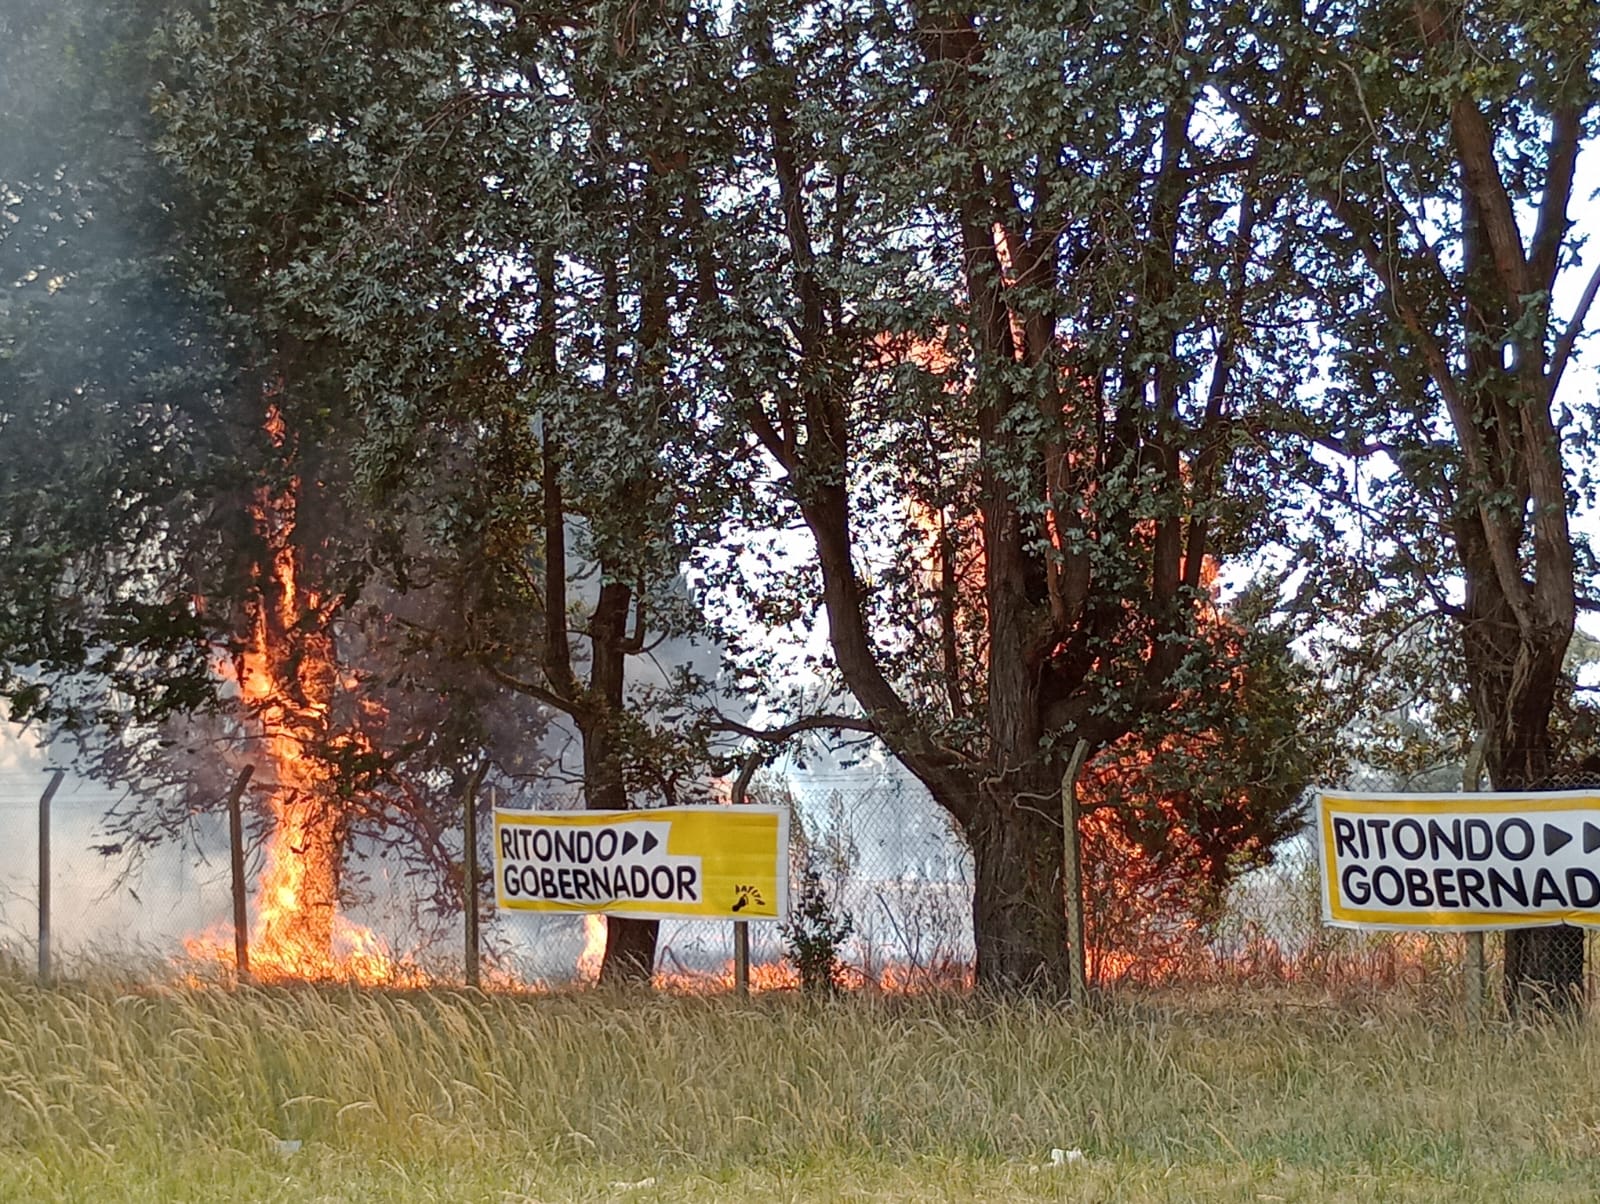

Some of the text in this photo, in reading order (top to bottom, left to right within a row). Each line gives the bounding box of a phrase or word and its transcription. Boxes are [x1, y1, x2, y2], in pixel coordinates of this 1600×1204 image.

[500, 828, 618, 863] RITONDO
[1333, 817, 1535, 861] RITONDO
[504, 864, 697, 901] GOBERNADOR
[1342, 864, 1600, 908] GOBERNAD
